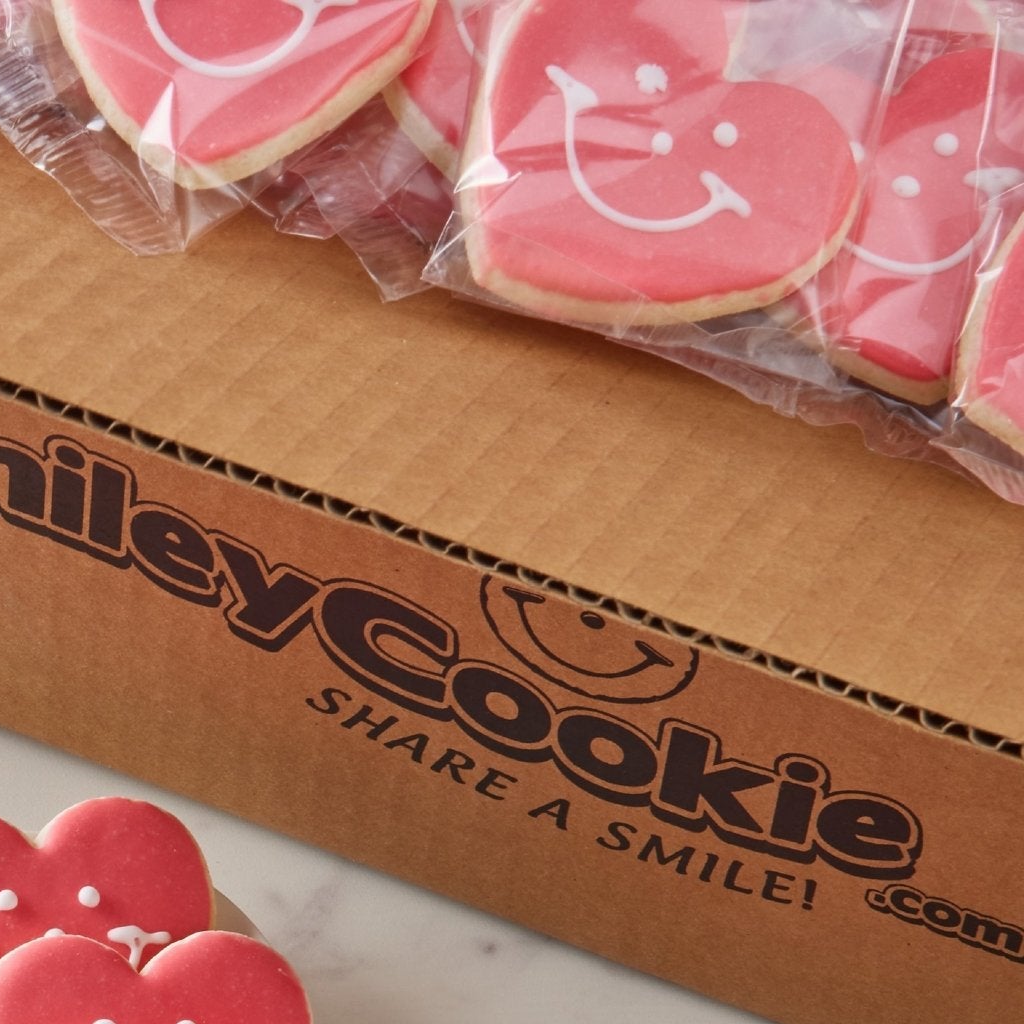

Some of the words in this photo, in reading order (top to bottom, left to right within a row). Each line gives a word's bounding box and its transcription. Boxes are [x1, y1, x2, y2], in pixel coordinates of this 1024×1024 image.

[306, 687, 517, 801] SHARE
[528, 799, 570, 831] A
[596, 821, 817, 911] SMILE!
[864, 884, 1024, 964] .com
